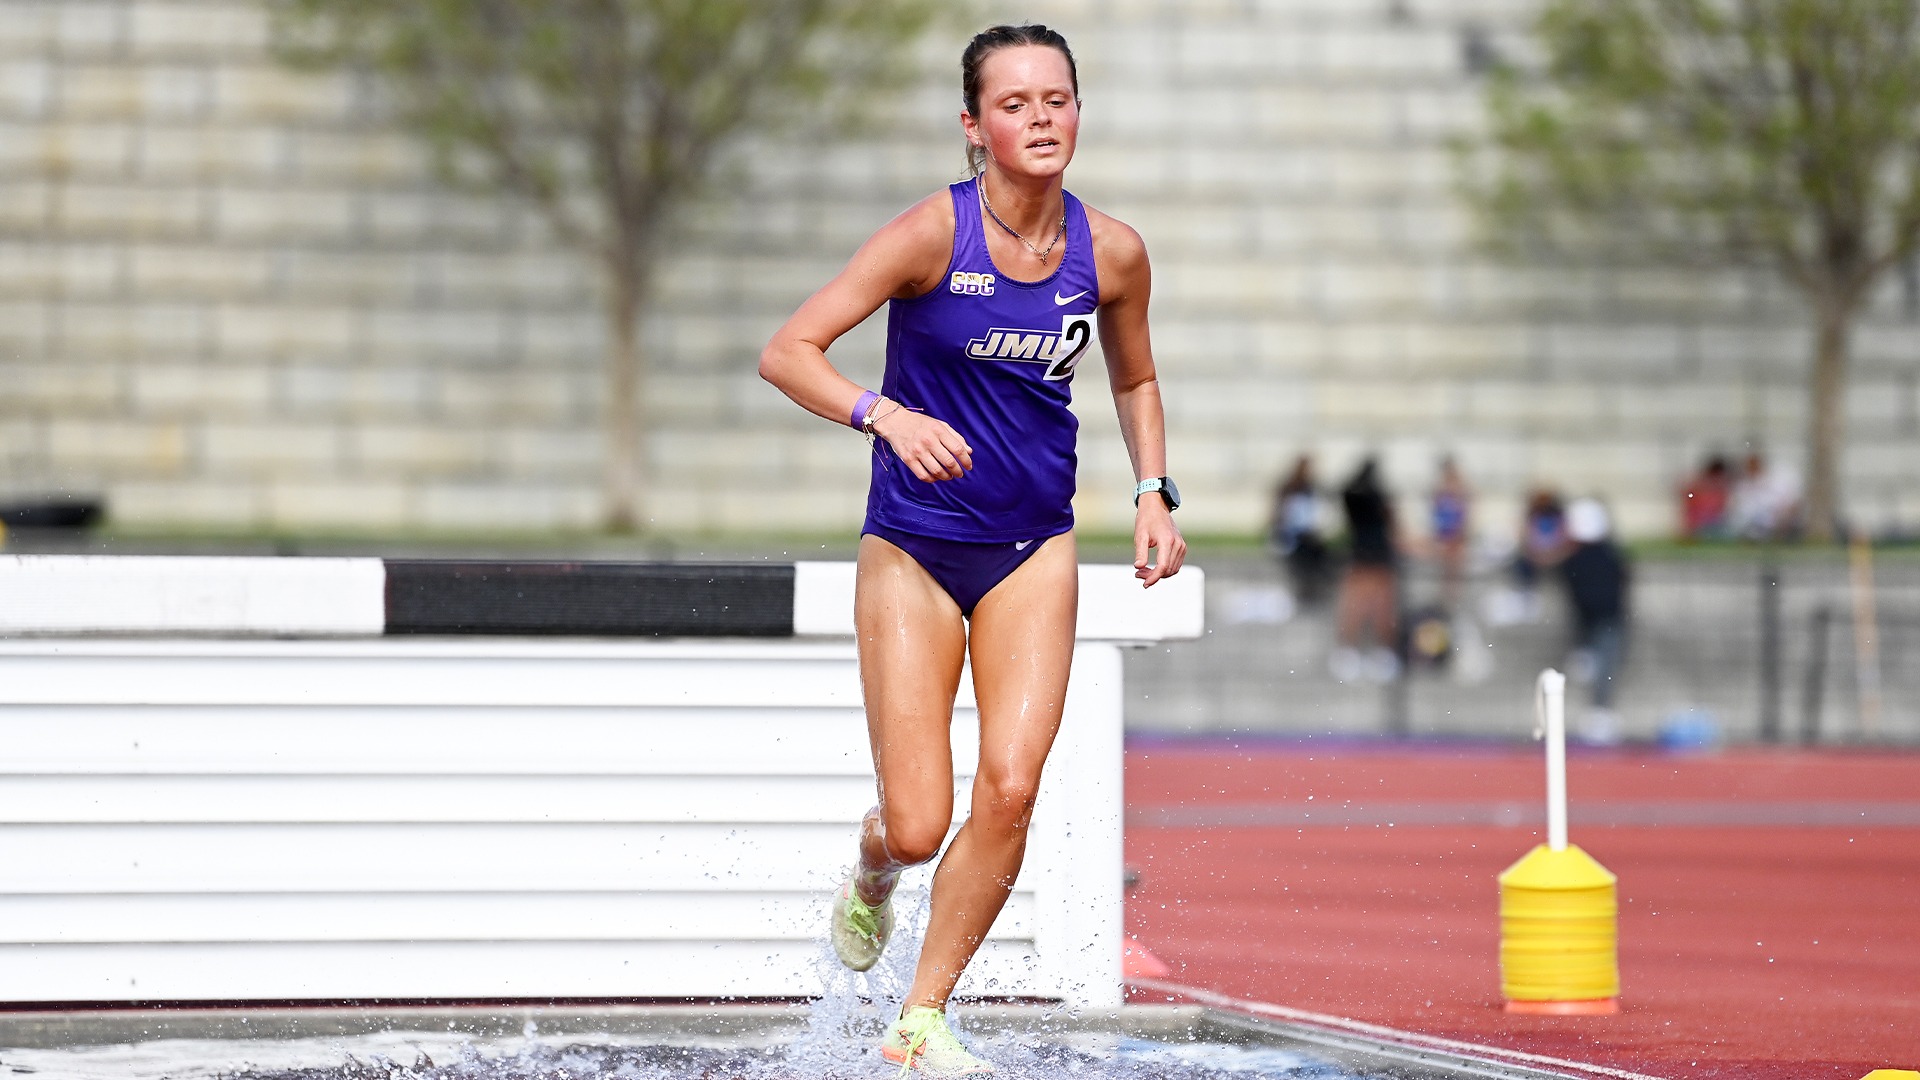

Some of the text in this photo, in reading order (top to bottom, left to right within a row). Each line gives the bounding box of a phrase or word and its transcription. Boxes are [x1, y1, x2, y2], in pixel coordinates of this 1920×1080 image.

[951, 272, 995, 296] SBC
[969, 331, 1062, 360] JMU
[1050, 319, 1091, 376] 2
